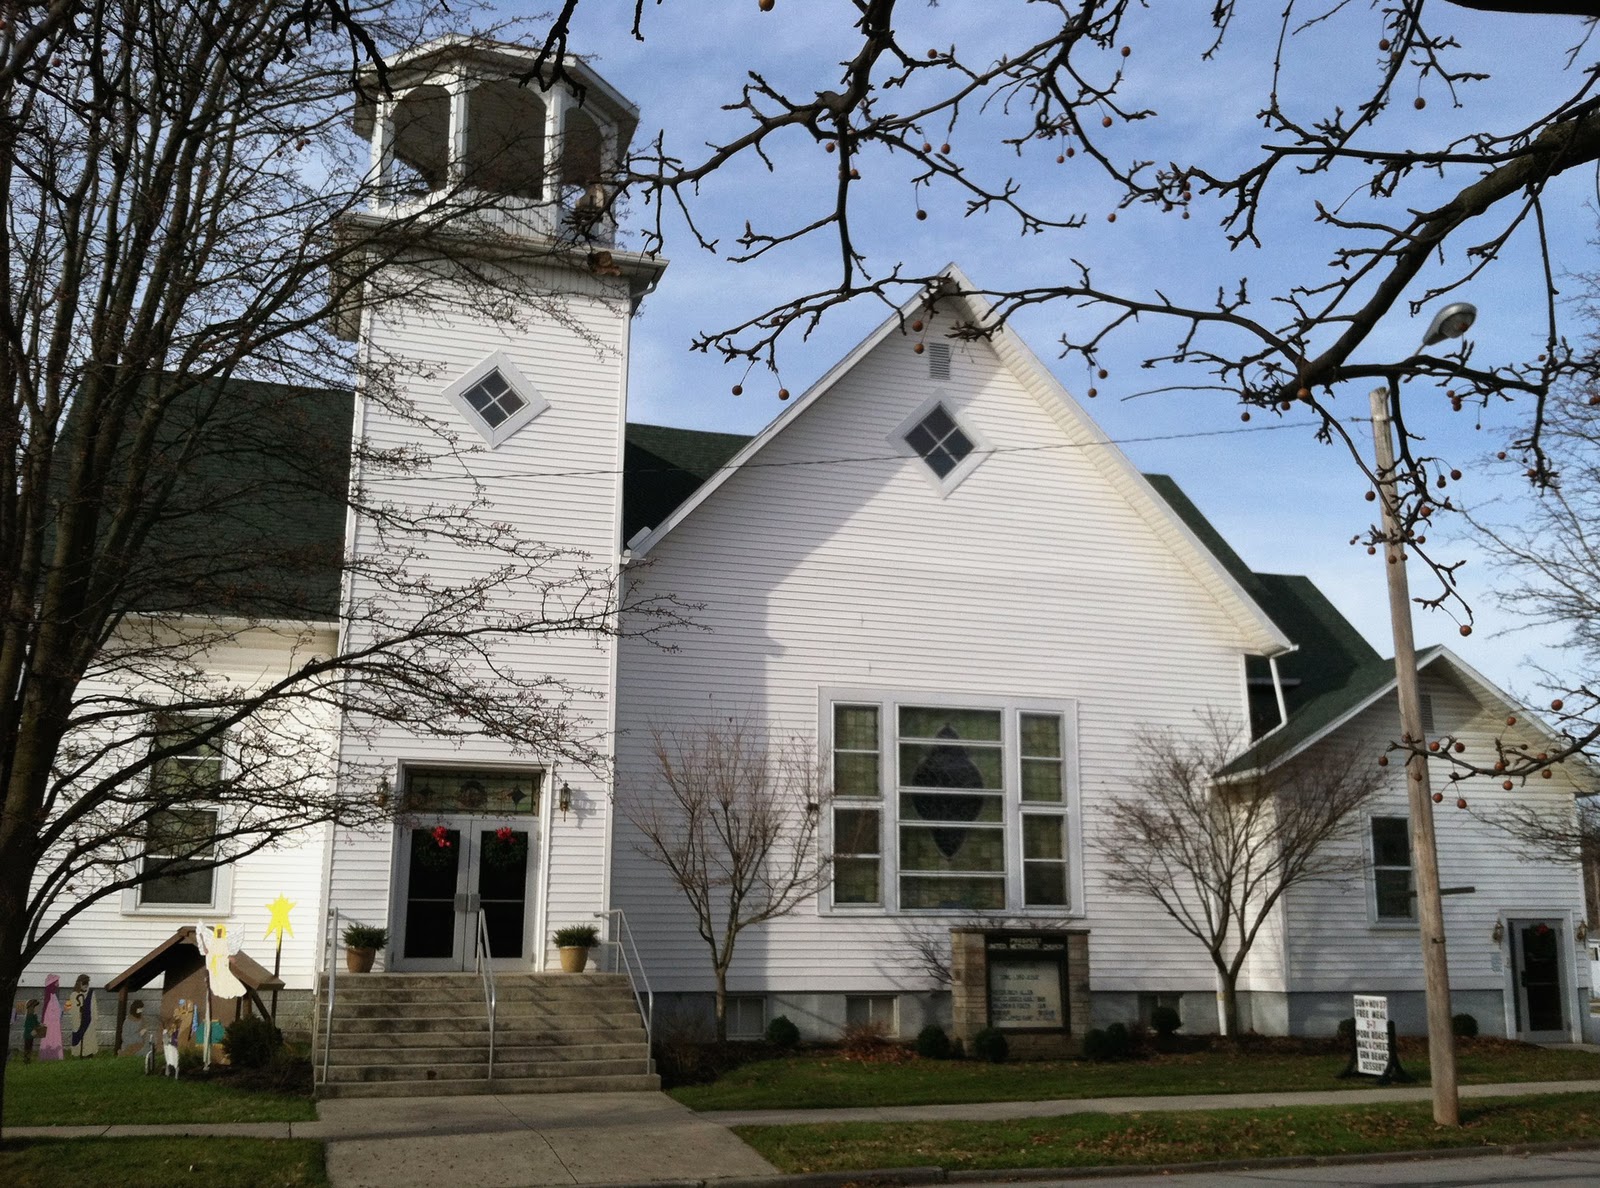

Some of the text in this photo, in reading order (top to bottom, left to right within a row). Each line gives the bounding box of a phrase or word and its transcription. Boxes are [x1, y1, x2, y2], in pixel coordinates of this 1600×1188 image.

[1356, 1009, 1387, 1020] FREE MEAL
[1356, 1030, 1370, 1038] PORK
[1371, 1052, 1388, 1061] BEANS
[1362, 1061, 1385, 1071] DESSERT
